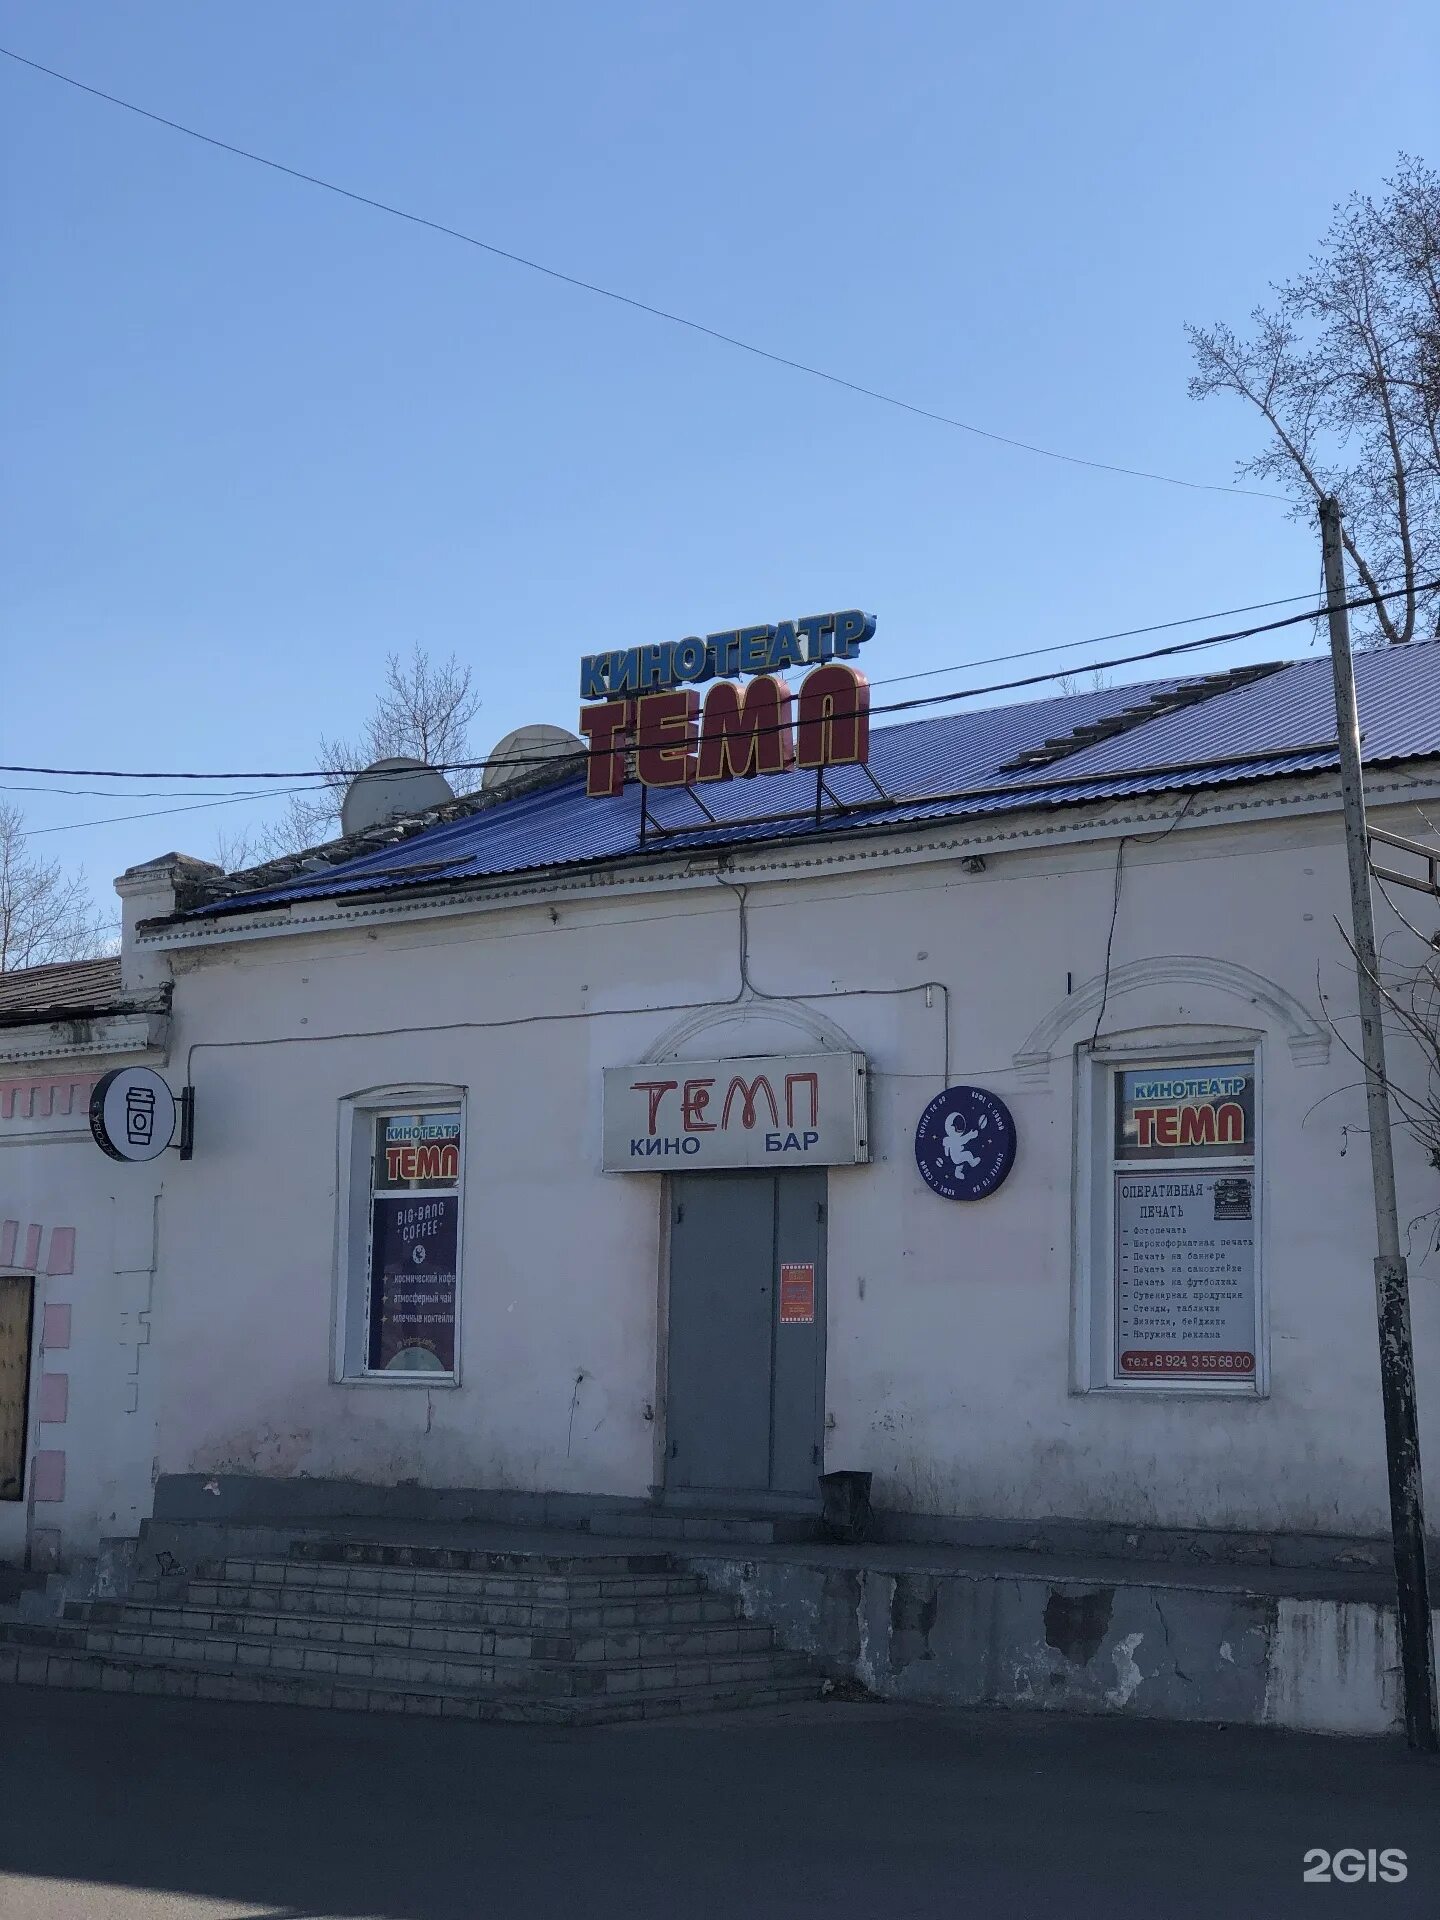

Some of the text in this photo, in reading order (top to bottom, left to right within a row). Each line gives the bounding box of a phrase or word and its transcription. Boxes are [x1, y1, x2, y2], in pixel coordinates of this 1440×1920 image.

[580, 609, 875, 698] КИНОТЕАТР
[579, 664, 870, 796] ТЕМП
[1134, 1077, 1245, 1099] КИНОТЕАТР
[629, 1073, 818, 1135] ТЕМП
[1133, 1103, 1245, 1147] ТЕМП
[387, 1124, 459, 1140] КИНОТЕАТР
[630, 1131, 819, 1156] КИНО БАР
[386, 1145, 459, 1180] ТЕМП
[1122, 1184, 1203, 1198] ОПЕРАТИВНАЯ
[1140, 1205, 1184, 1218] ПЕЧАТЬ
[403, 1220, 438, 1240] COFFEE
[1133, 1227, 1187, 1235] Фотопечать
[1133, 1240, 1215, 1249] Широкоформатная
[1187, 1252, 1226, 1261] баннере
[1187, 1264, 1242, 1273] самоклейке
[1186, 1278, 1238, 1288] футболках
[1133, 1292, 1243, 1300] Сувенирная продукция
[1133, 1305, 1170, 1313] Стенды,
[1133, 1330, 1220, 1339] Наружная реклама
[1165, 1355, 1188, 1367] 924
[1191, 1356, 1199, 1367] 3
[1202, 1356, 1217, 1368] 55
